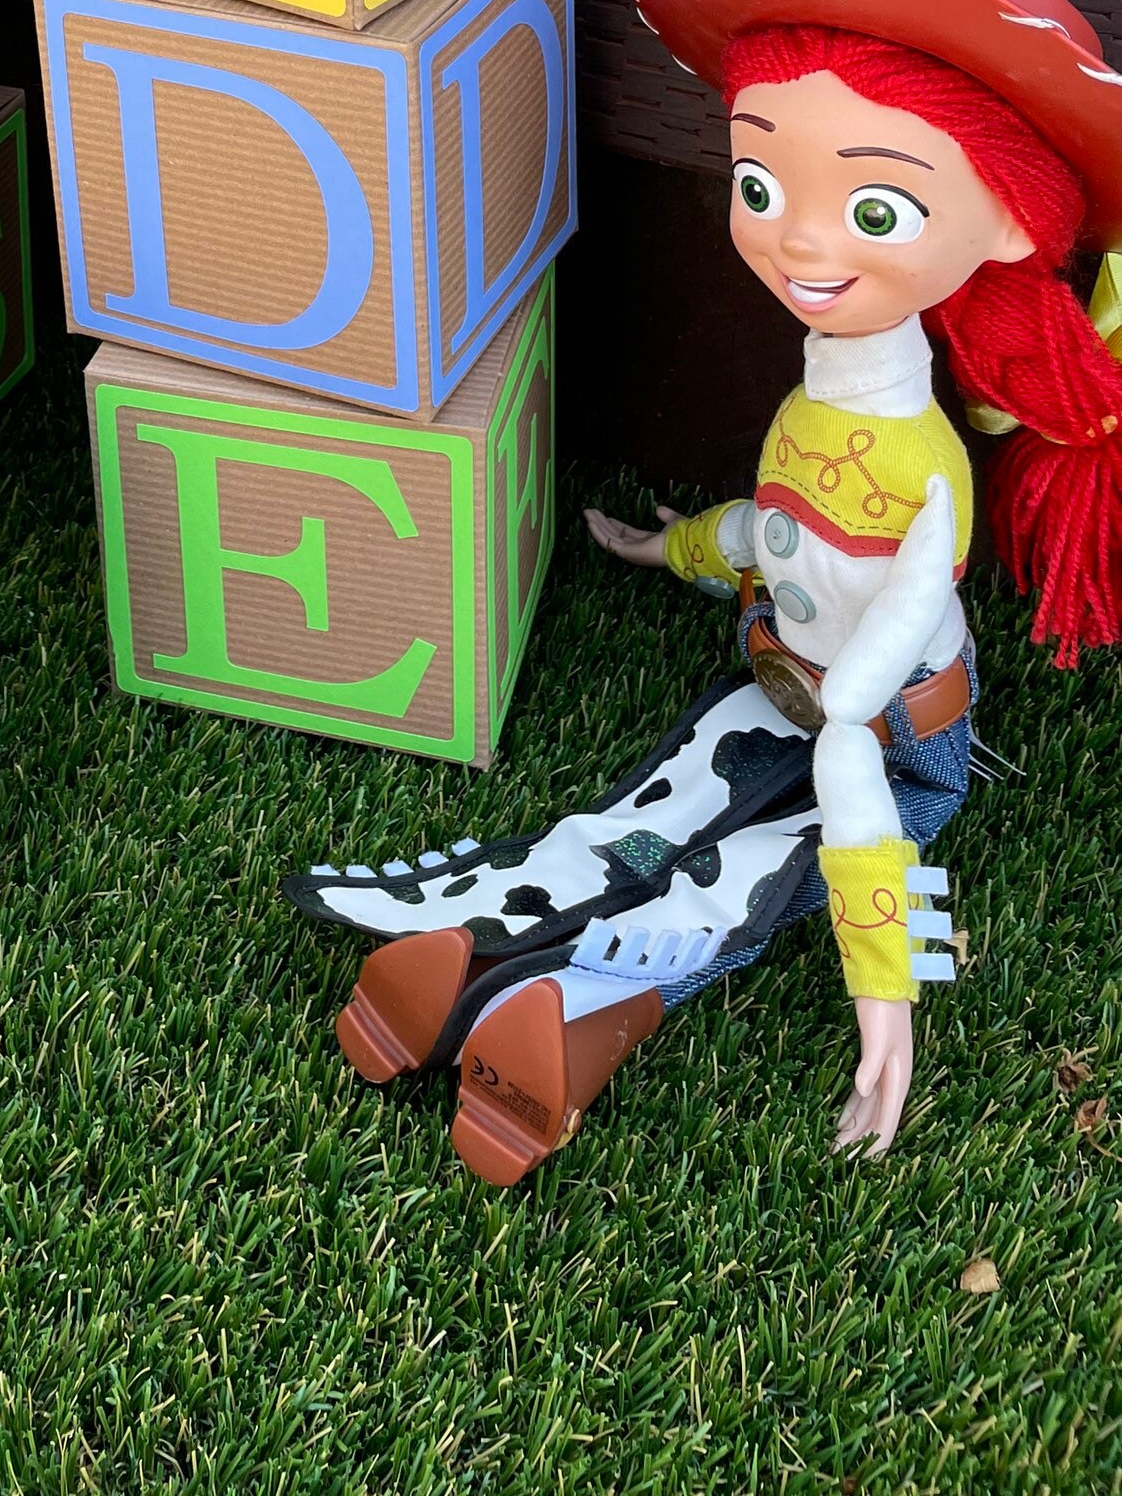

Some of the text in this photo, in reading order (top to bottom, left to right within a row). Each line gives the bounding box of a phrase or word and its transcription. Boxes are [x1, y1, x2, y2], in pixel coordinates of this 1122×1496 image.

[82, 42, 374, 350] D
[136, 423, 438, 719] E
[497, 315, 551, 700] E
[470, 1055, 499, 1086] CE
